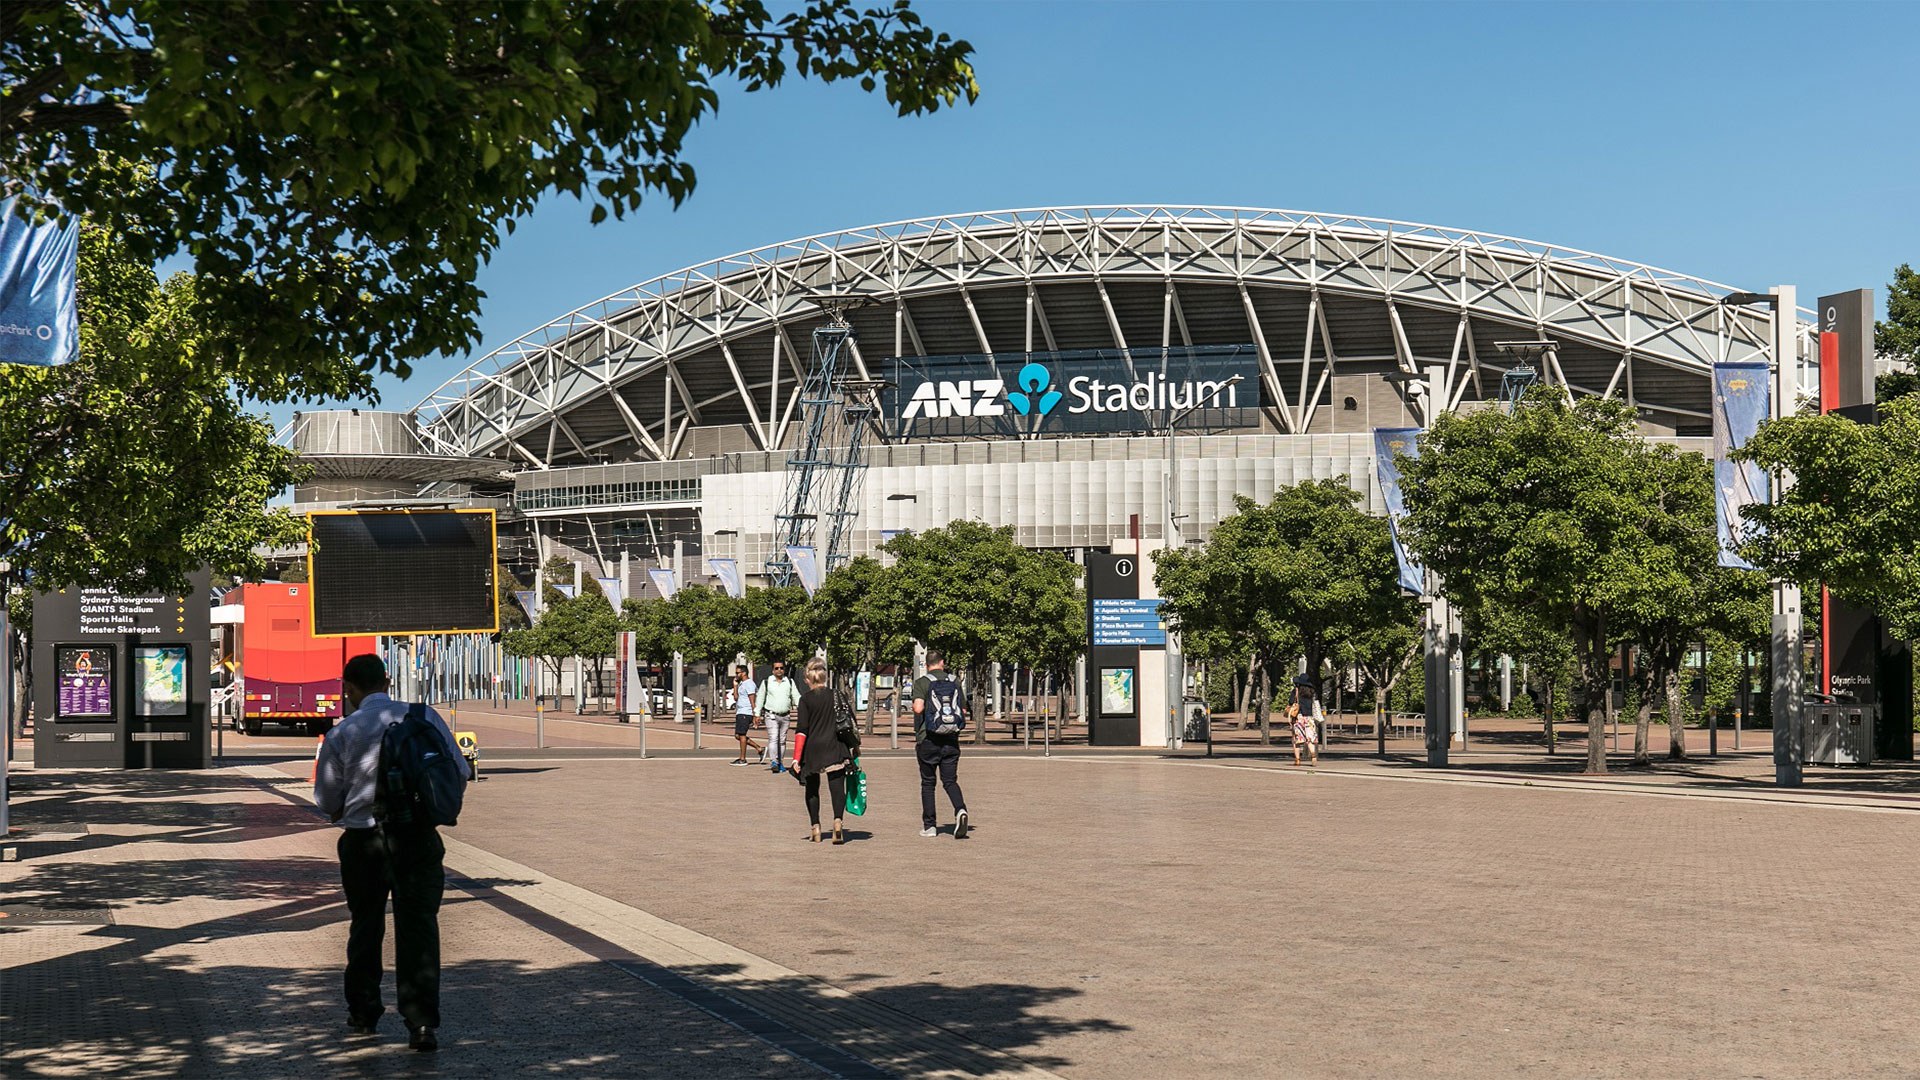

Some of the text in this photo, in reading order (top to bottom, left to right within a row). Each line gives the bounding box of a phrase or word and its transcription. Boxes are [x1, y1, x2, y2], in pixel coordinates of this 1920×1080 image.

[901, 371, 1237, 419] ANZ Stadium
[80, 596, 165, 605] Sydney Showground
[80, 615, 133, 624] Sports Halls
[80, 626, 161, 635] Monster Skatepark
[1831, 675, 1871, 687] Olympic Park
